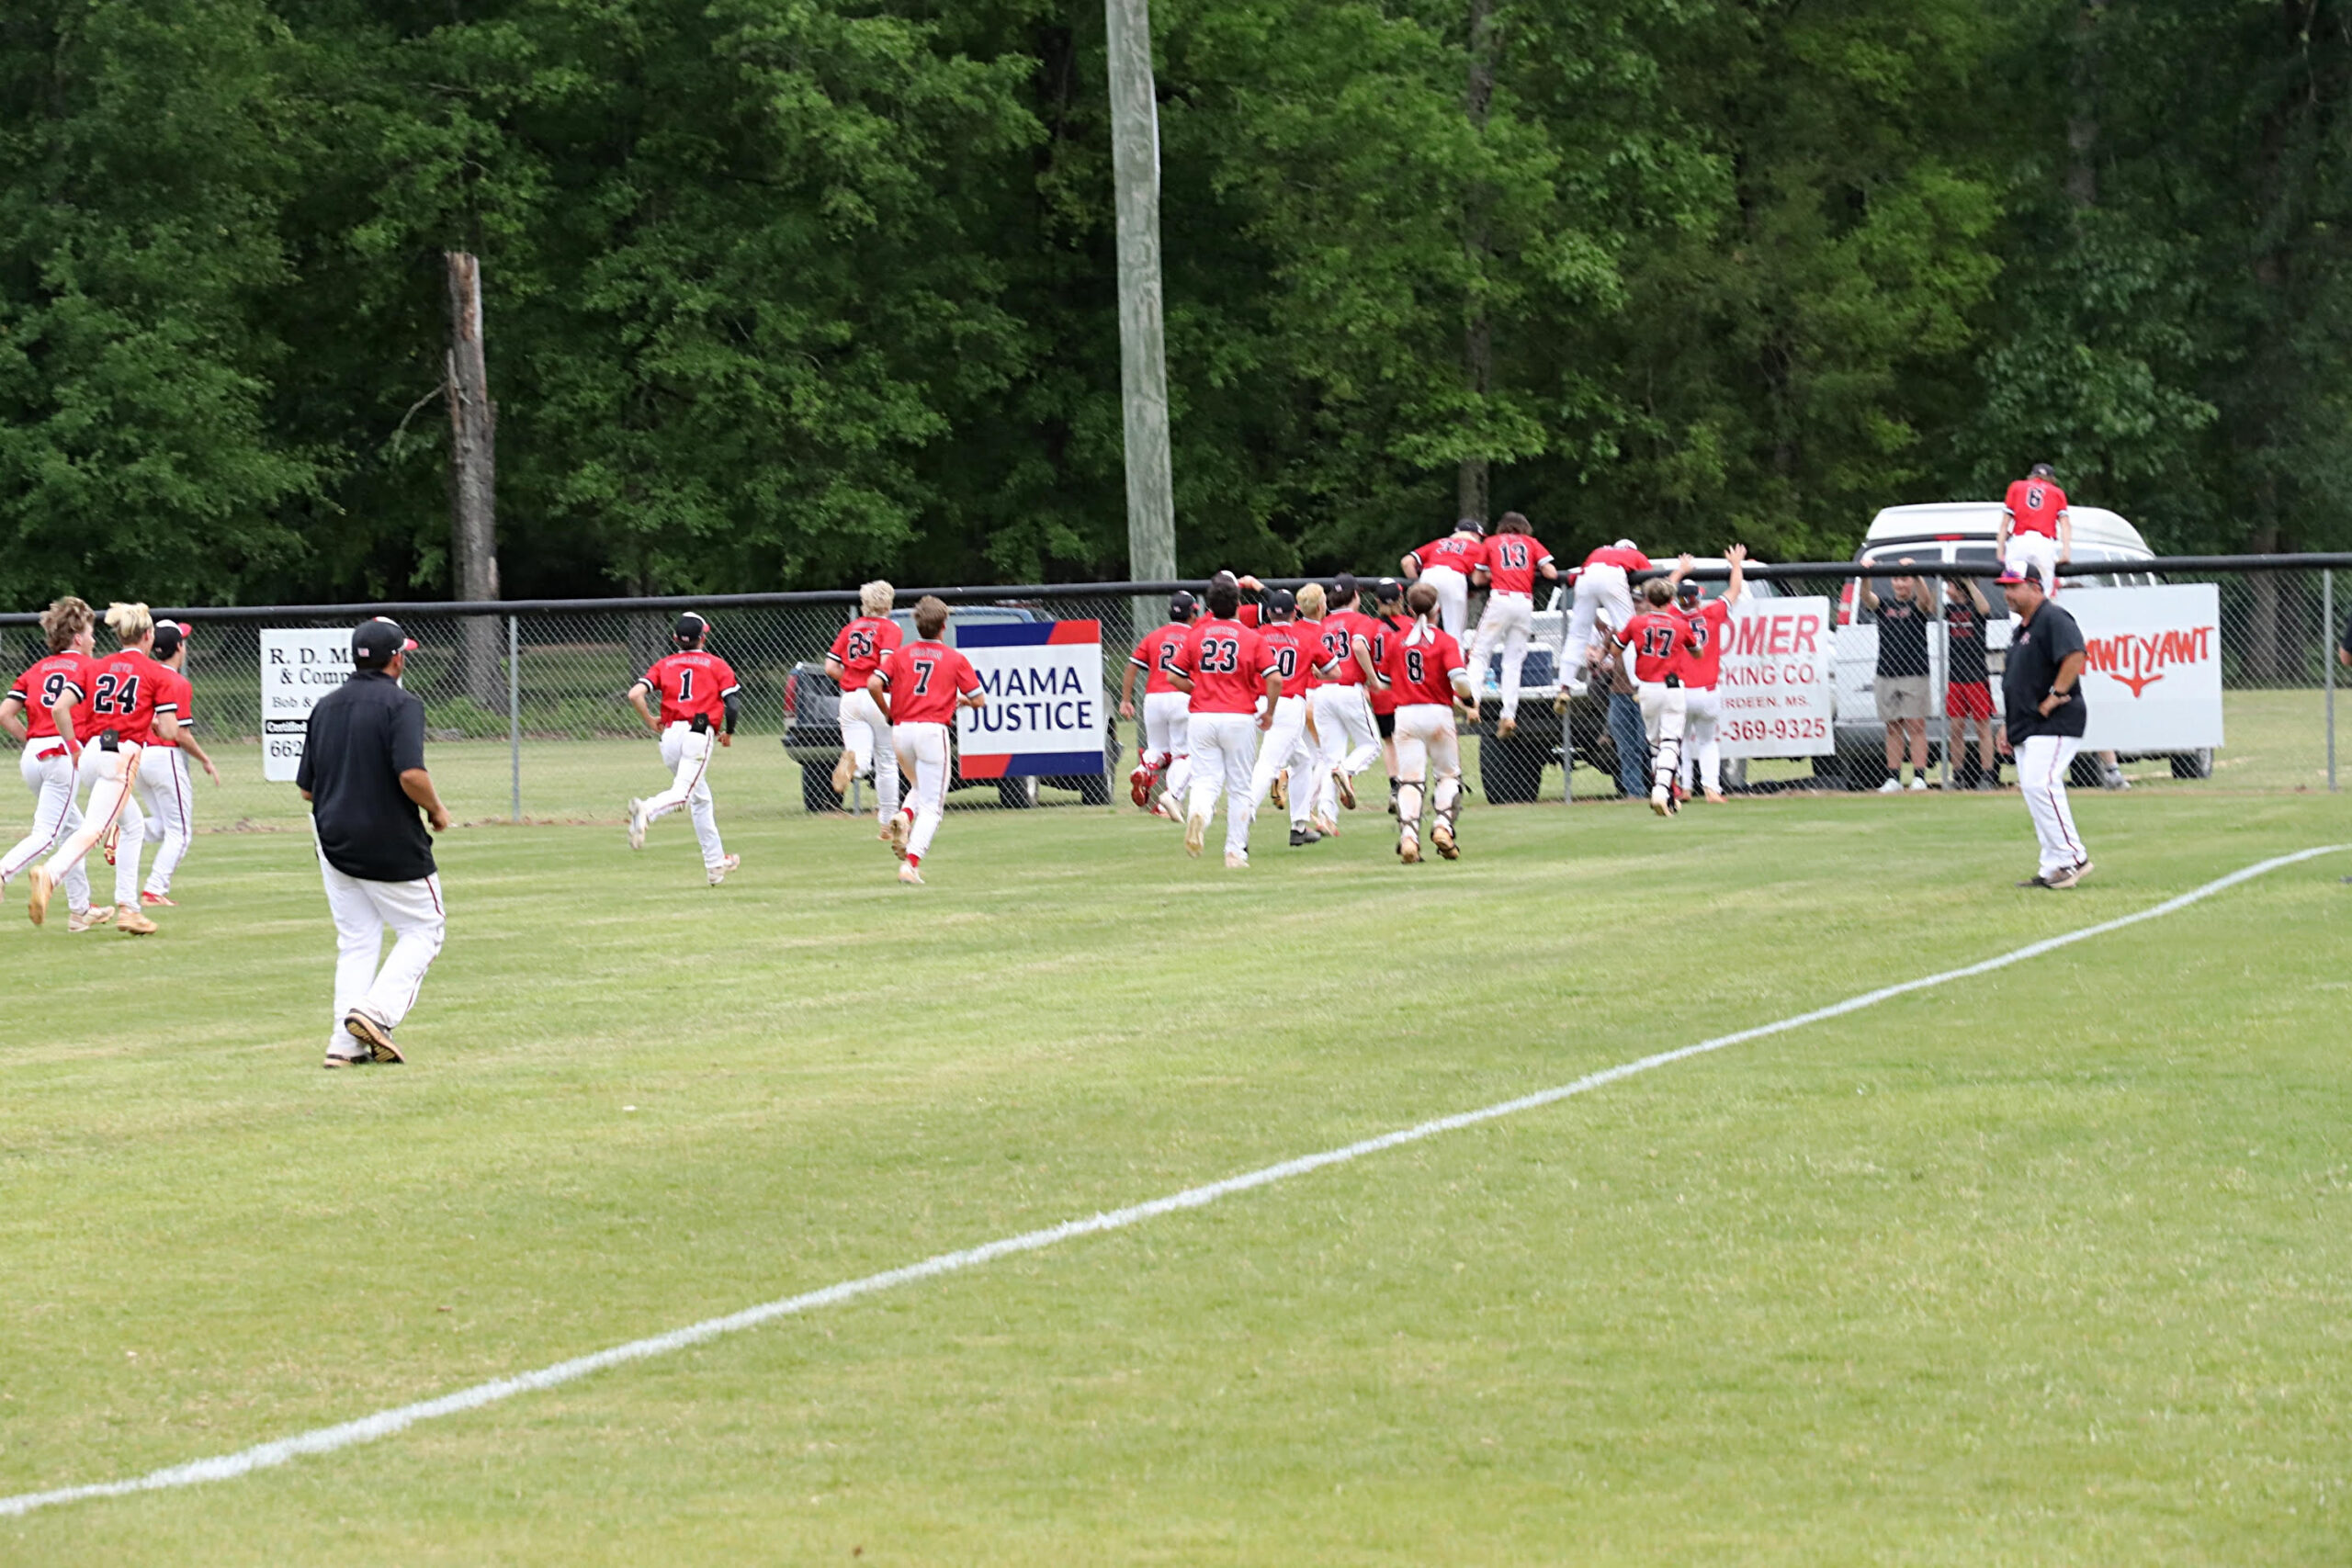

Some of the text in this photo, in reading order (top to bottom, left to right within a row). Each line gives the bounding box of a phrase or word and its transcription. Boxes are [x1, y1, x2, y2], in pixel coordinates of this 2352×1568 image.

[2026, 486, 2046, 512] 6
[1498, 541, 1529, 571] 13
[269, 648, 291, 664] R.
[300, 648, 322, 664] D.
[1199, 637, 1239, 673] 23
[1642, 626, 1676, 659] 17
[2079, 626, 2215, 676] AWT YAWT
[280, 668, 351, 684] & Comp
[913, 660, 934, 696] 7
[975, 666, 1083, 697] MAMA
[1405, 649, 1425, 685] 8
[1718, 662, 1821, 687] KING CO.
[40, 672, 65, 708] 9
[94, 673, 140, 715] 24
[677, 668, 694, 704] 1
[967, 700, 1093, 733] JUSTICE
